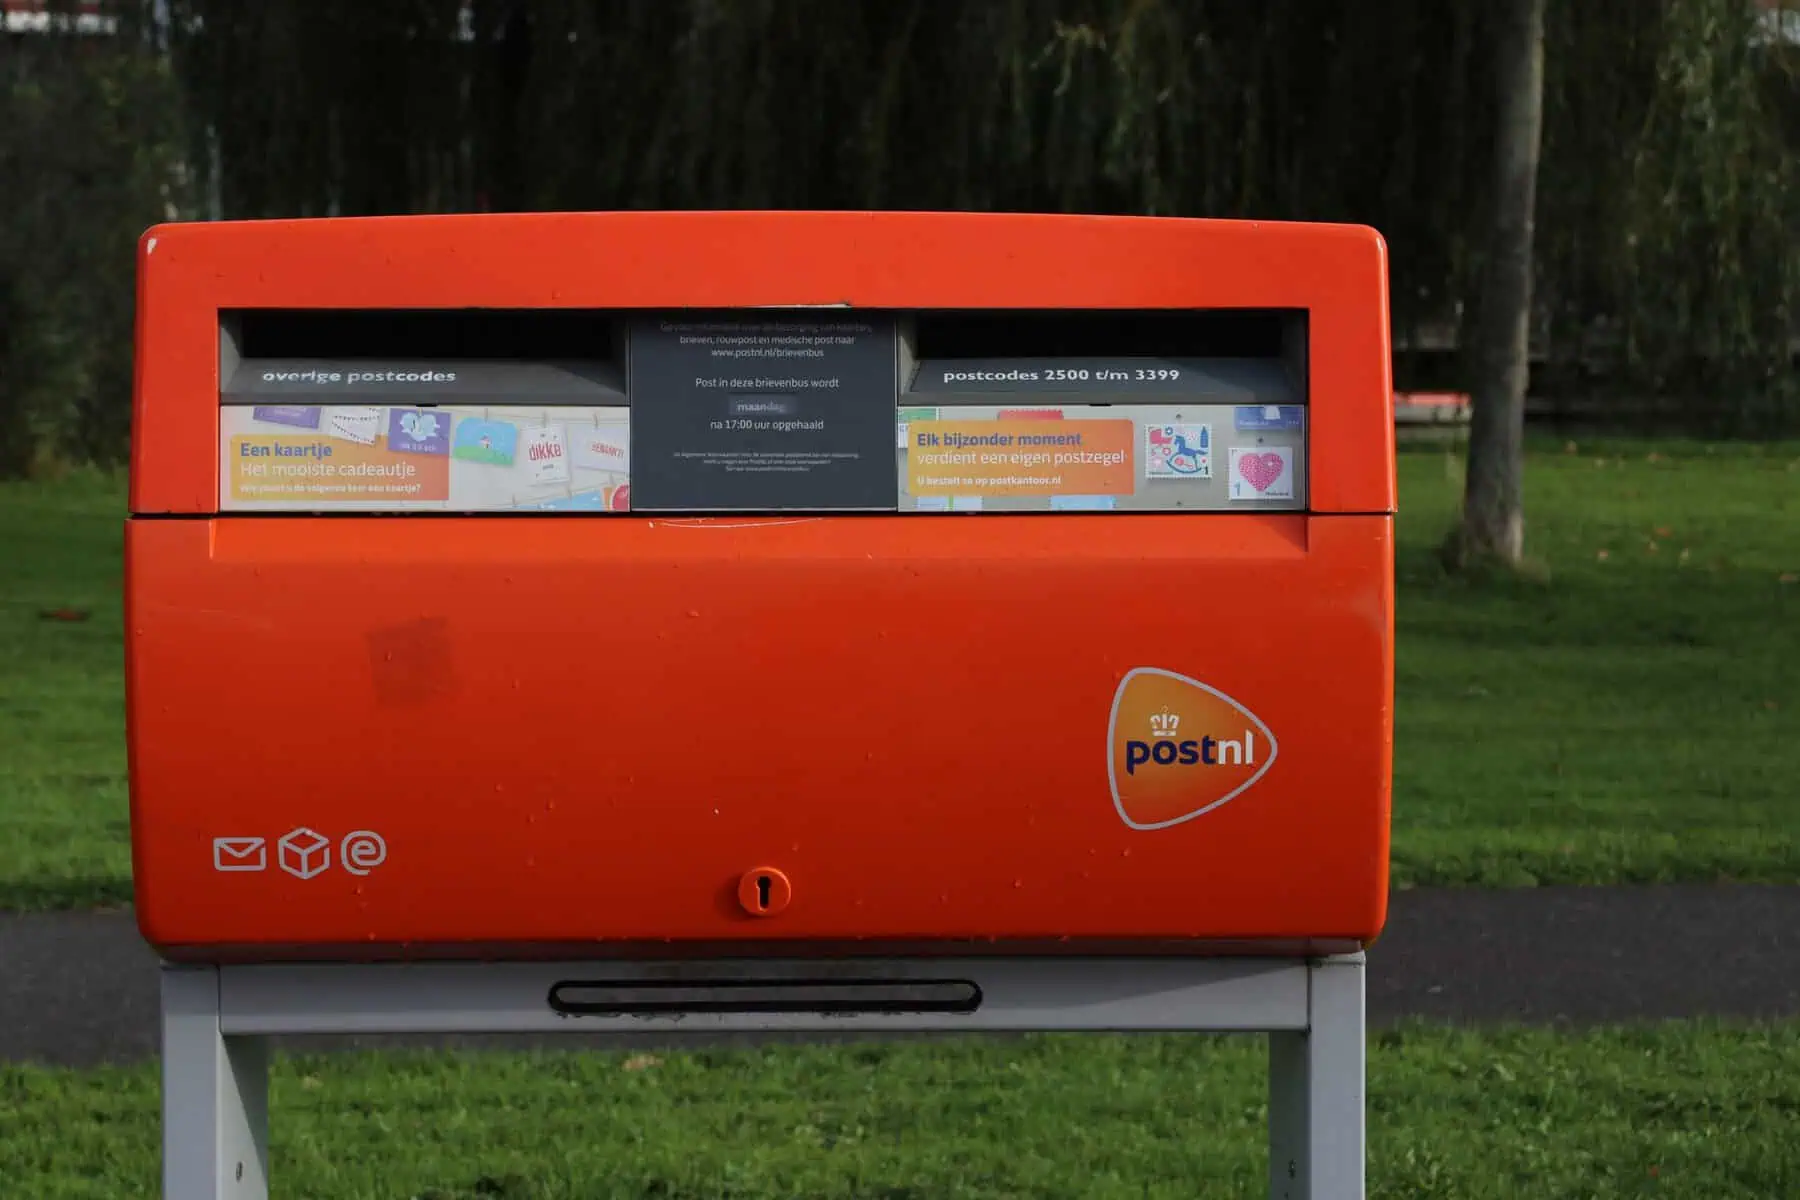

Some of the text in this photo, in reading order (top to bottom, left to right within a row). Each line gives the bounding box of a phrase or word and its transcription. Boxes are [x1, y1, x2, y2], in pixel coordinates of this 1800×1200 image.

[680, 335, 714, 345] brieven,
[758, 337, 770, 345] en
[771, 335, 813, 345] medische
[814, 336, 834, 346] post
[835, 337, 855, 345] naar
[262, 370, 457, 384] overige postcodes
[695, 376, 839, 388] Post in deze brievenbus wordt
[943, 369, 1181, 383] postcodes 2500 t/m 3399
[710, 419, 824, 432] na 17:00 uur opgehaald
[917, 432, 1082, 449] Elk bijzonder moment
[240, 442, 333, 460] Een kaartje
[917, 451, 1125, 469] verdient een eigen postzegel
[240, 461, 416, 480] Het mooiste cadeautje
[916, 477, 924, 486] U
[975, 477, 989, 488] op
[990, 476, 1062, 488] postkantoor.nl
[1126, 729, 1254, 776] postnl
